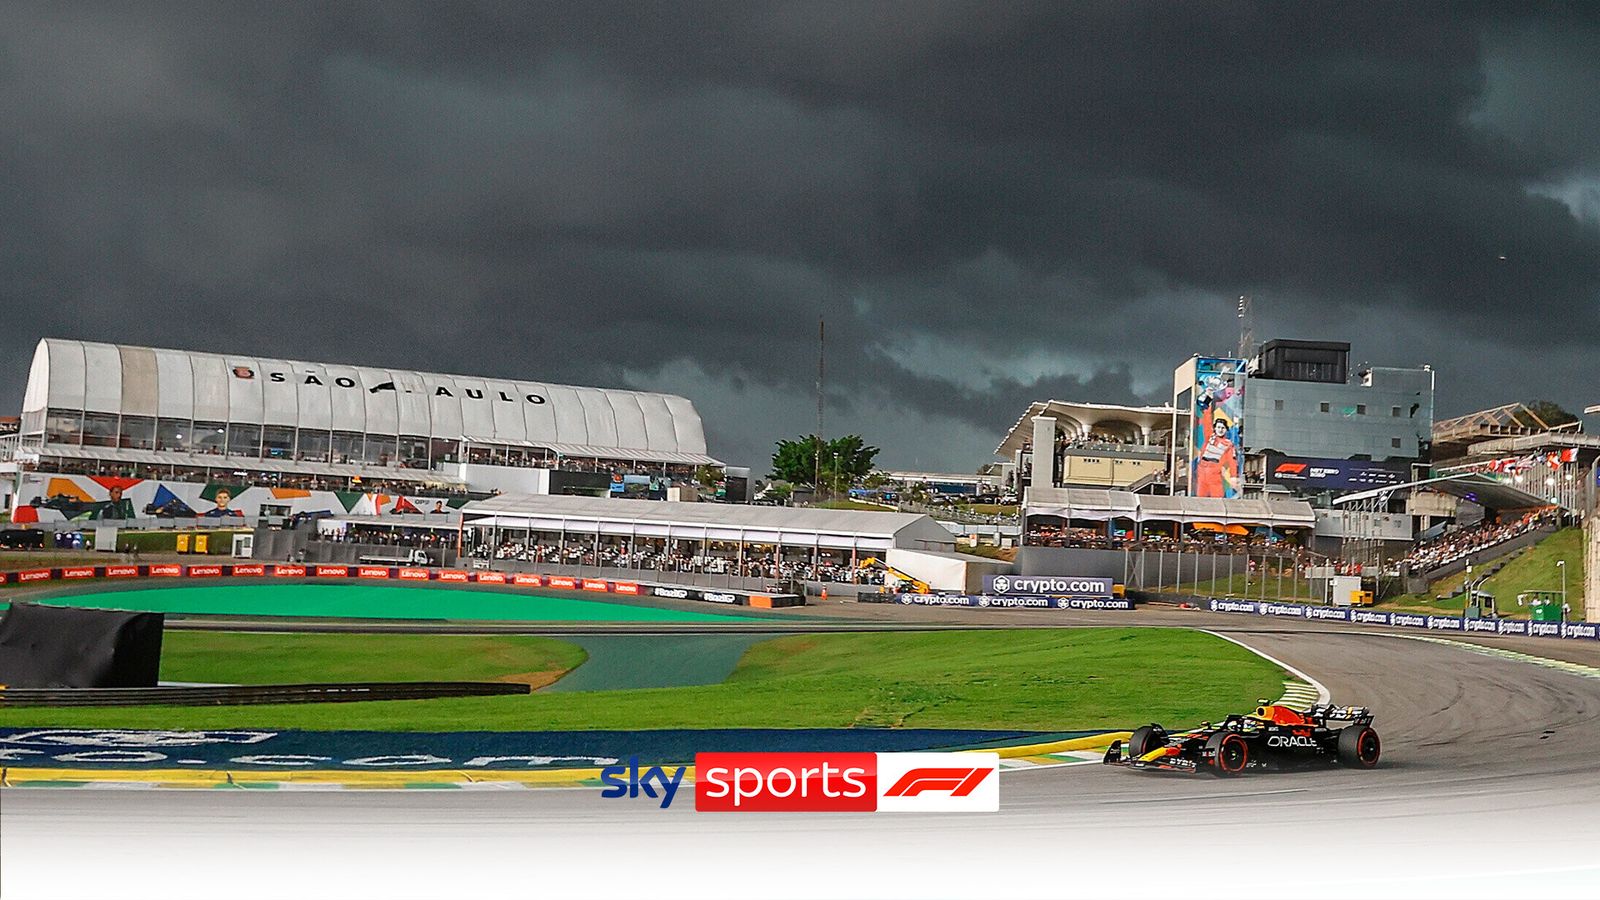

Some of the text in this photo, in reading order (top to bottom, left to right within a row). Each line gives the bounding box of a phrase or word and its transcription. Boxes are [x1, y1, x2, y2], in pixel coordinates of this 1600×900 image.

[270, 370, 356, 388] SÃO
[65, 569, 93, 577] Lenovo
[108, 568, 136, 576] Lenovo
[152, 567, 179, 575] Lenovo
[192, 568, 220, 576] Lenovo
[235, 567, 262, 575] Lenovo
[319, 568, 346, 576] Lenovo
[361, 569, 387, 577] Lenovo
[401, 570, 428, 578] Lenovo
[21, 572, 49, 580] Lenovo
[441, 572, 466, 580] Lenovo
[480, 573, 504, 582] Lenovo
[516, 575, 538, 584] Lenovo
[551, 578, 574, 587] Lenovo
[585, 581, 606, 590] Lenovo
[1013, 577, 1105, 595] crypto.com
[616, 583, 637, 592] Lenovo
[914, 595, 969, 606] crypto.com
[992, 596, 1048, 607] crypto.com
[1070, 598, 1128, 609] crypto.com
[1267, 735, 1317, 747] ORACLE
